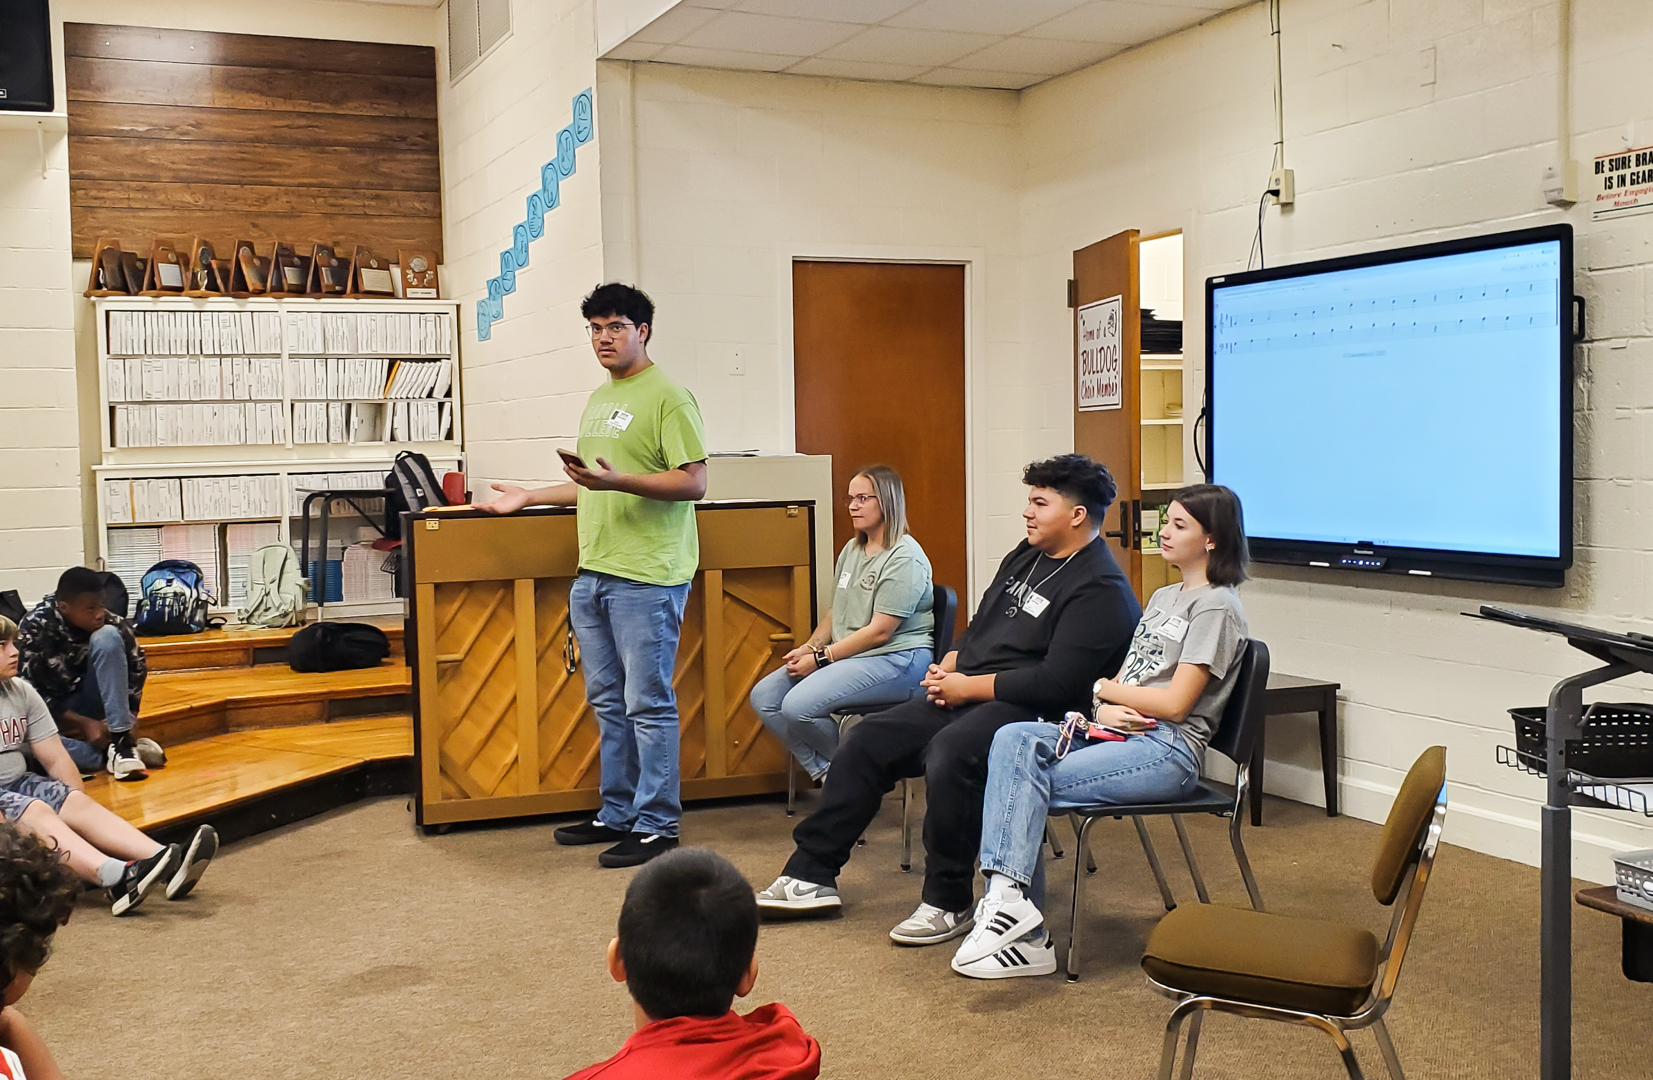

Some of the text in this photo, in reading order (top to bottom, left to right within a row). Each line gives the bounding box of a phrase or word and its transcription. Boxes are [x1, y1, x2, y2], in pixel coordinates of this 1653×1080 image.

[1595, 161, 1605, 174] BE
[1609, 156, 1631, 172] SURE
[1604, 169, 1653, 190] IS IN GEAR
[1597, 193, 1621, 201] Before
[1614, 198, 1638, 207] Mouth
[1096, 320, 1102, 340] of
[1081, 344, 1118, 376] BULLDOG
[1096, 376, 1118, 399] Member
